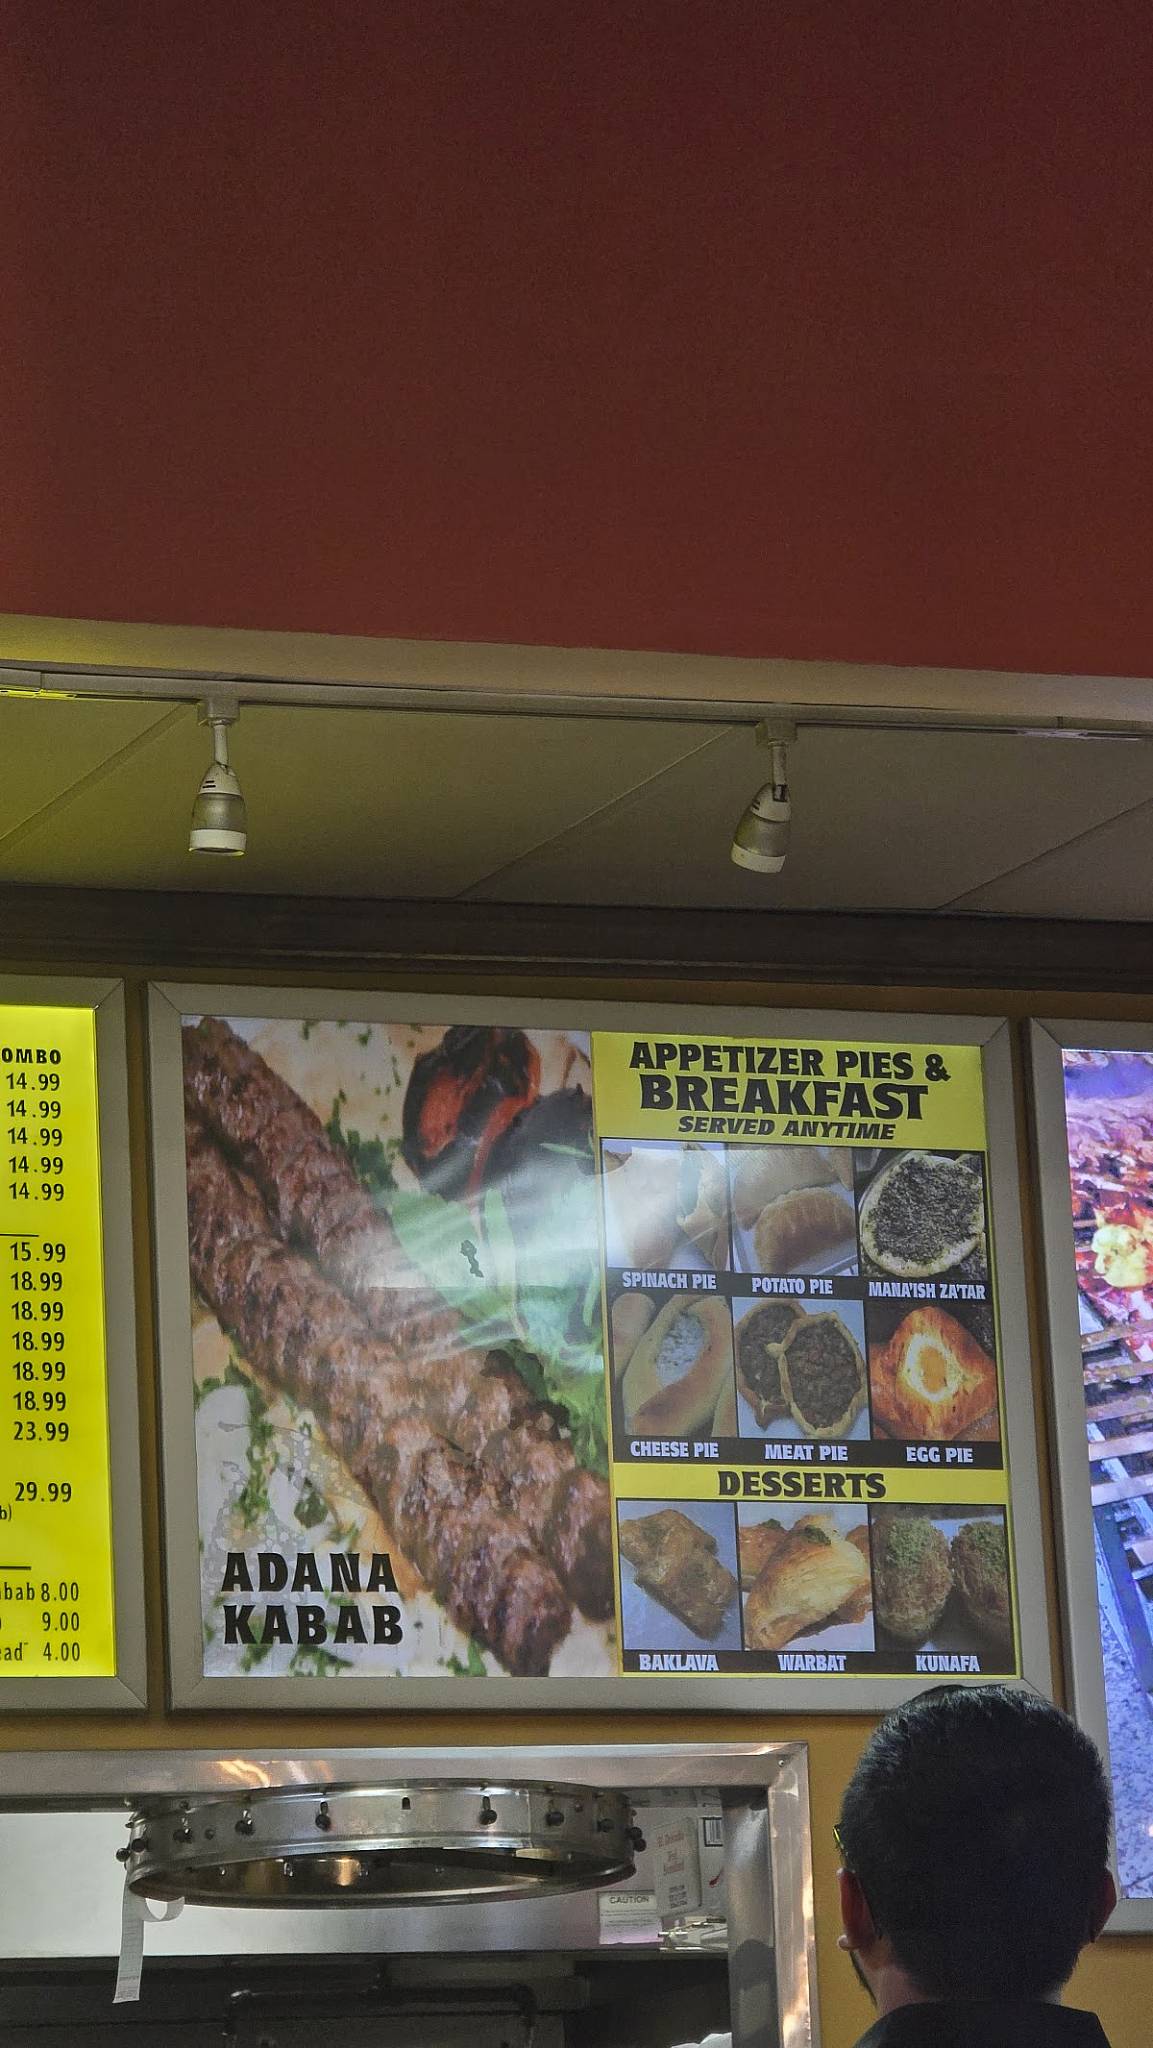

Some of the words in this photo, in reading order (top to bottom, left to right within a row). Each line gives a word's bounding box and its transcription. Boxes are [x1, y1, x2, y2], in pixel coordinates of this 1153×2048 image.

[0, 1047, 62, 1065] OMBO
[629, 1041, 824, 1077] APPETIZER
[836, 1049, 914, 1081] PIES
[925, 1053, 952, 1082] &
[6, 1072, 61, 1092] 14.99
[640, 1074, 929, 1120] BREAKFAST
[6, 1099, 62, 1119] 14.99
[8, 1127, 63, 1147] 14.99
[678, 1115, 776, 1137] SERVED
[781, 1120, 897, 1140] ANYTIME
[8, 1155, 64, 1175] 14.99
[9, 1182, 65, 1202] 14.99
[10, 1241, 66, 1263] 15.99
[10, 1271, 63, 1292] 18.99
[622, 1271, 688, 1289] SPINACH
[692, 1274, 717, 1290] PIE
[752, 1277, 806, 1295] POTATO
[810, 1279, 833, 1295] PIE
[868, 1281, 936, 1298] MANA'ISH
[940, 1283, 986, 1299] ZA'TAR
[11, 1301, 64, 1322] 18.99
[12, 1331, 65, 1352] 18.99
[13, 1361, 66, 1382] 18.99
[13, 1391, 67, 1412] 18.99
[14, 1421, 69, 1442] 23.99
[630, 1440, 689, 1458] CHEESE
[693, 1442, 719, 1459] PIE
[764, 1443, 815, 1461] MEAT
[818, 1444, 848, 1462] PIE
[906, 1446, 941, 1463] EGG
[945, 1447, 974, 1464] PIE
[15, 1481, 72, 1503] 29.99
[717, 1470, 887, 1499] DESSERTS
[220, 1552, 399, 1593] ADANA
[0, 1582, 35, 1601] bab
[41, 1582, 79, 1602] 8.00
[42, 1612, 80, 1632] 9.00
[223, 1605, 404, 1645] KABAB
[43, 1642, 80, 1662] 4.00
[639, 1654, 719, 1672] BAKLAVA
[777, 1654, 848, 1672] WARBAT
[915, 1654, 981, 1673] KUNAFA
[609, 1895, 649, 1904] CAUTION
